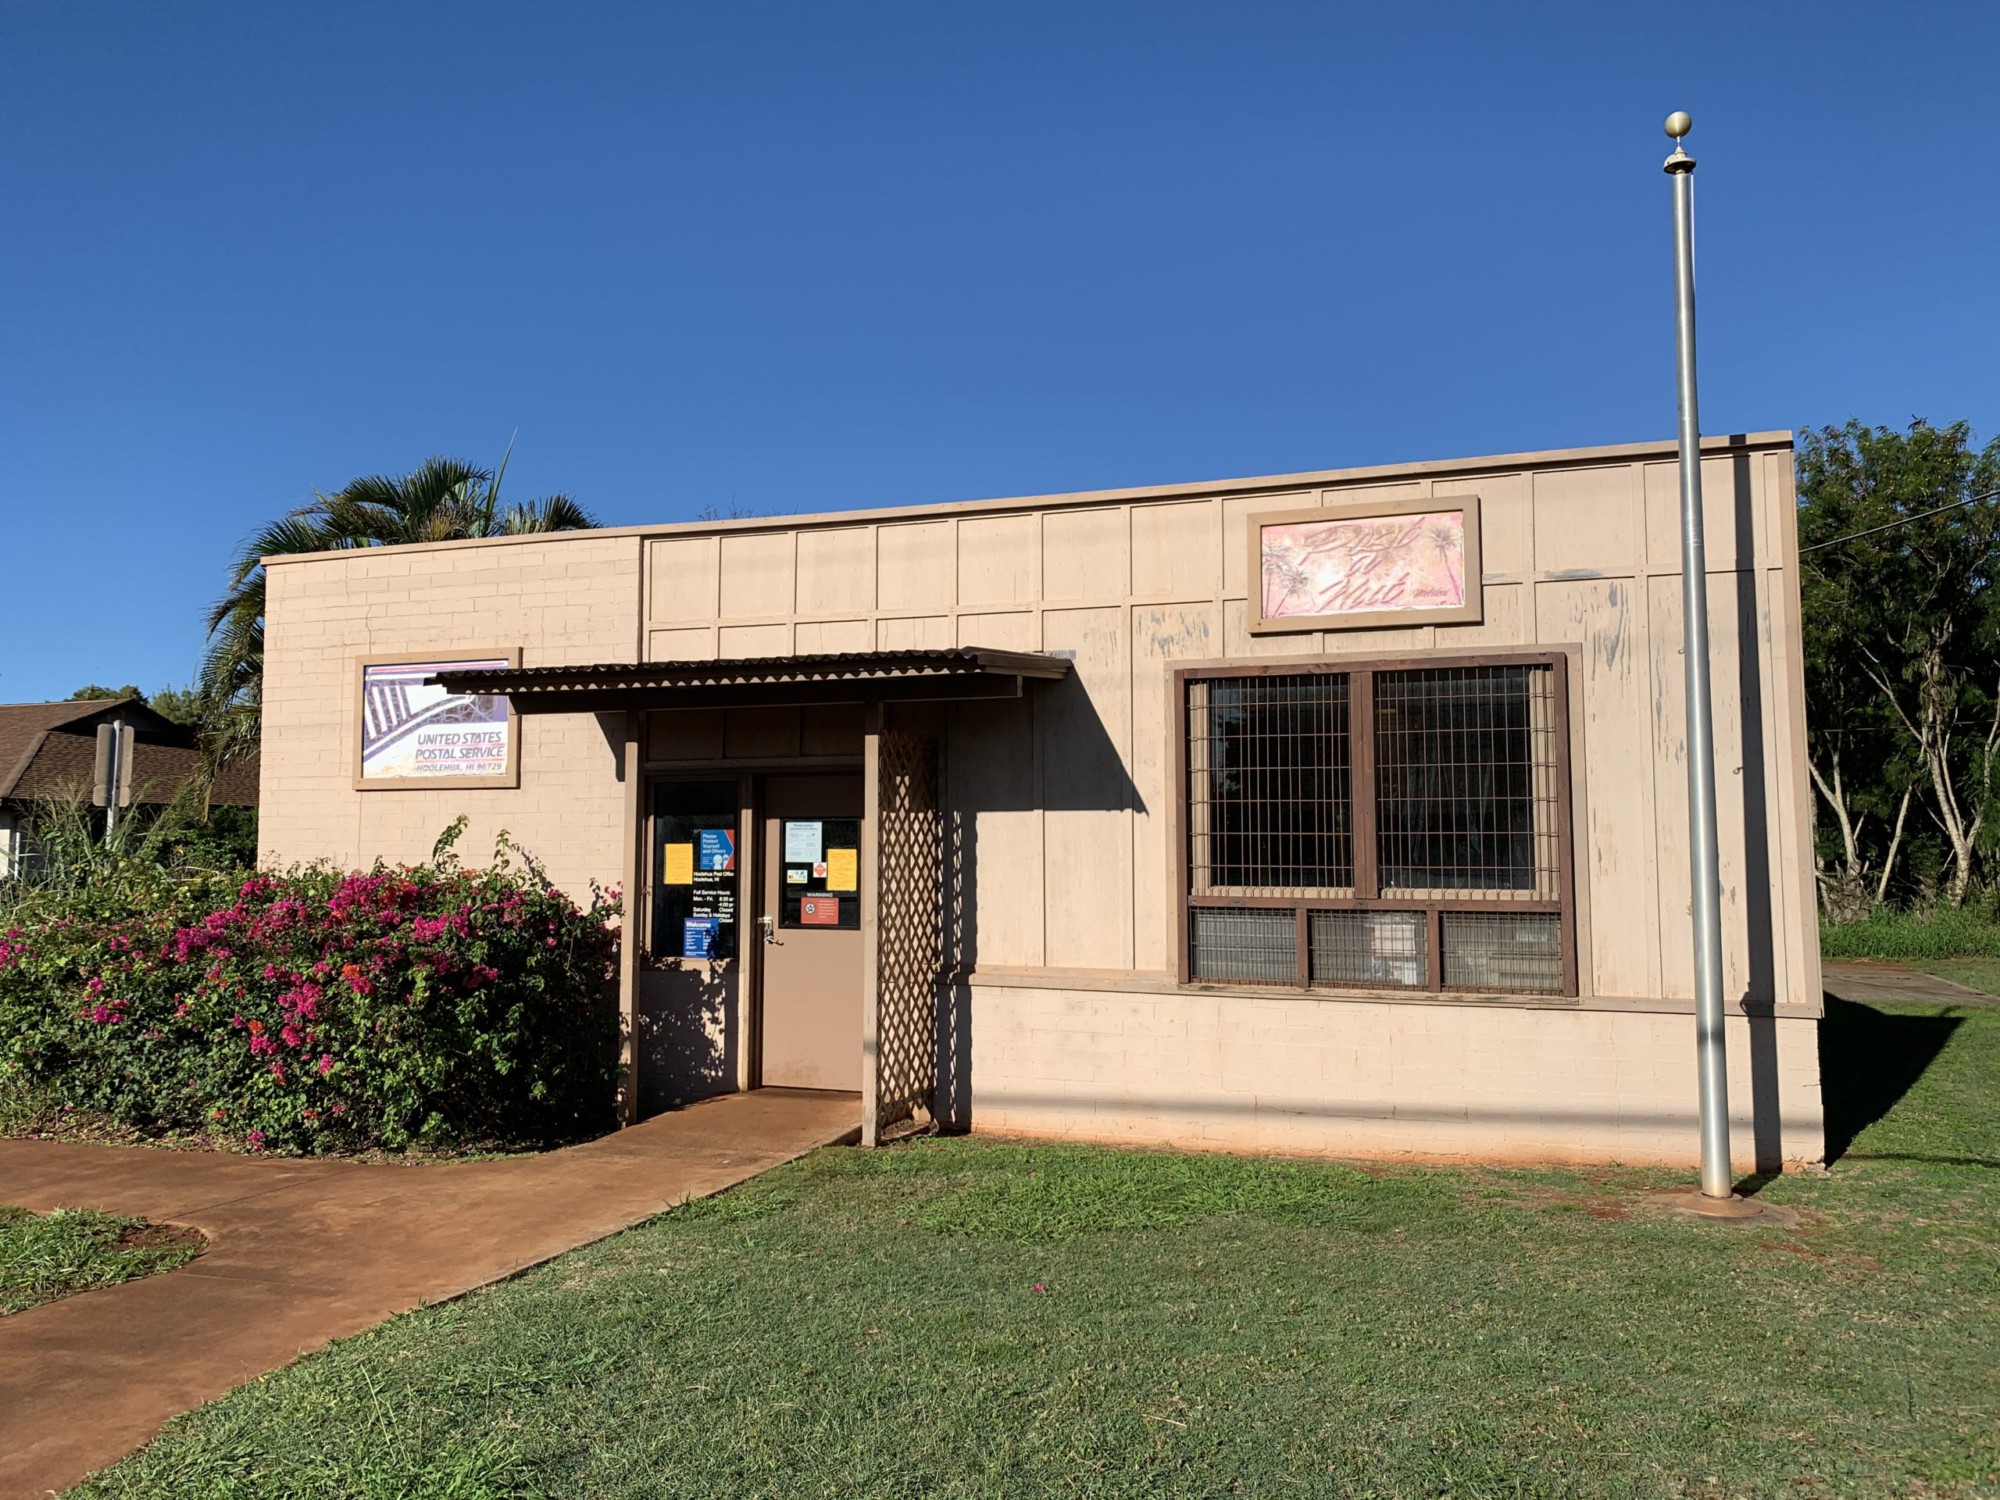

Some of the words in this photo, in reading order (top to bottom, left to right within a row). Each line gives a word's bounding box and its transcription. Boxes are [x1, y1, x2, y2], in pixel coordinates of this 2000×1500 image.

[418, 733, 461, 745] UNITED
[462, 731, 502, 744] STATES
[415, 748, 456, 760] POSTAL
[459, 746, 504, 758] SERVICE
[466, 763, 475, 771] HI
[477, 762, 502, 771] 96729
